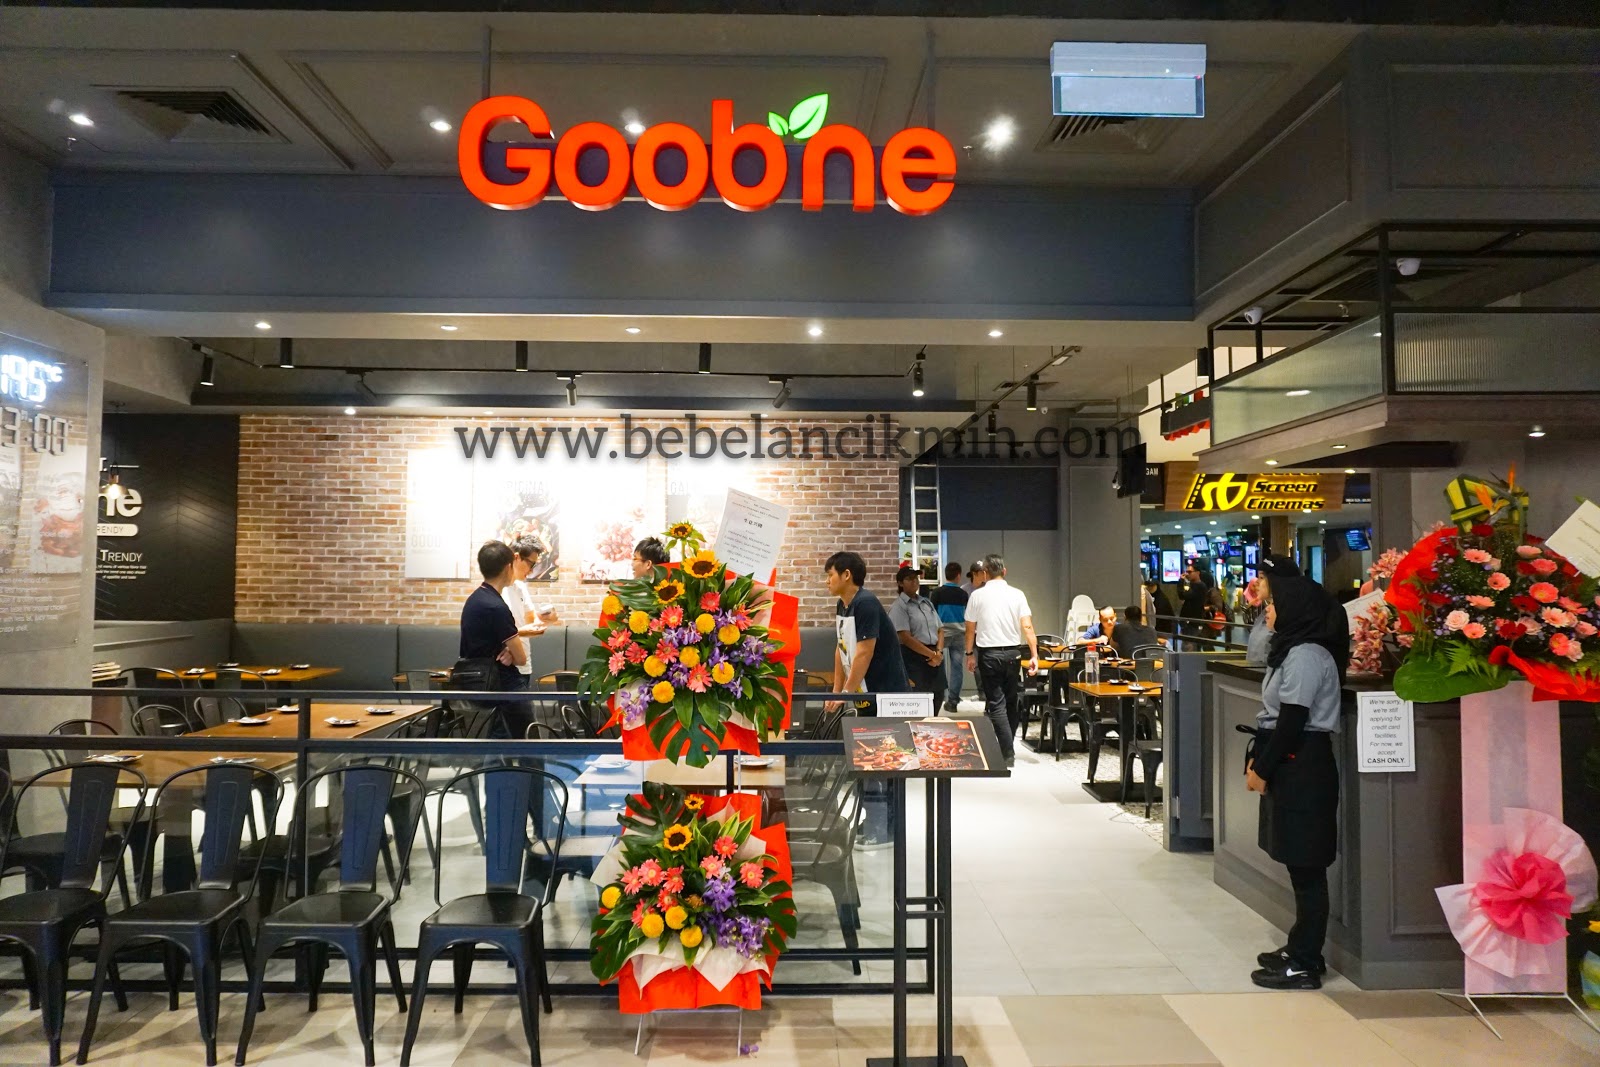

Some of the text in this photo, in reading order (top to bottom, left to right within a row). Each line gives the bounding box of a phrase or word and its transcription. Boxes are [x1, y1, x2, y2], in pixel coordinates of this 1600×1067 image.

[458, 96, 957, 216] Goobne
[1253, 480, 1319, 494] Screen
[1246, 497, 1325, 510] Cinemas
